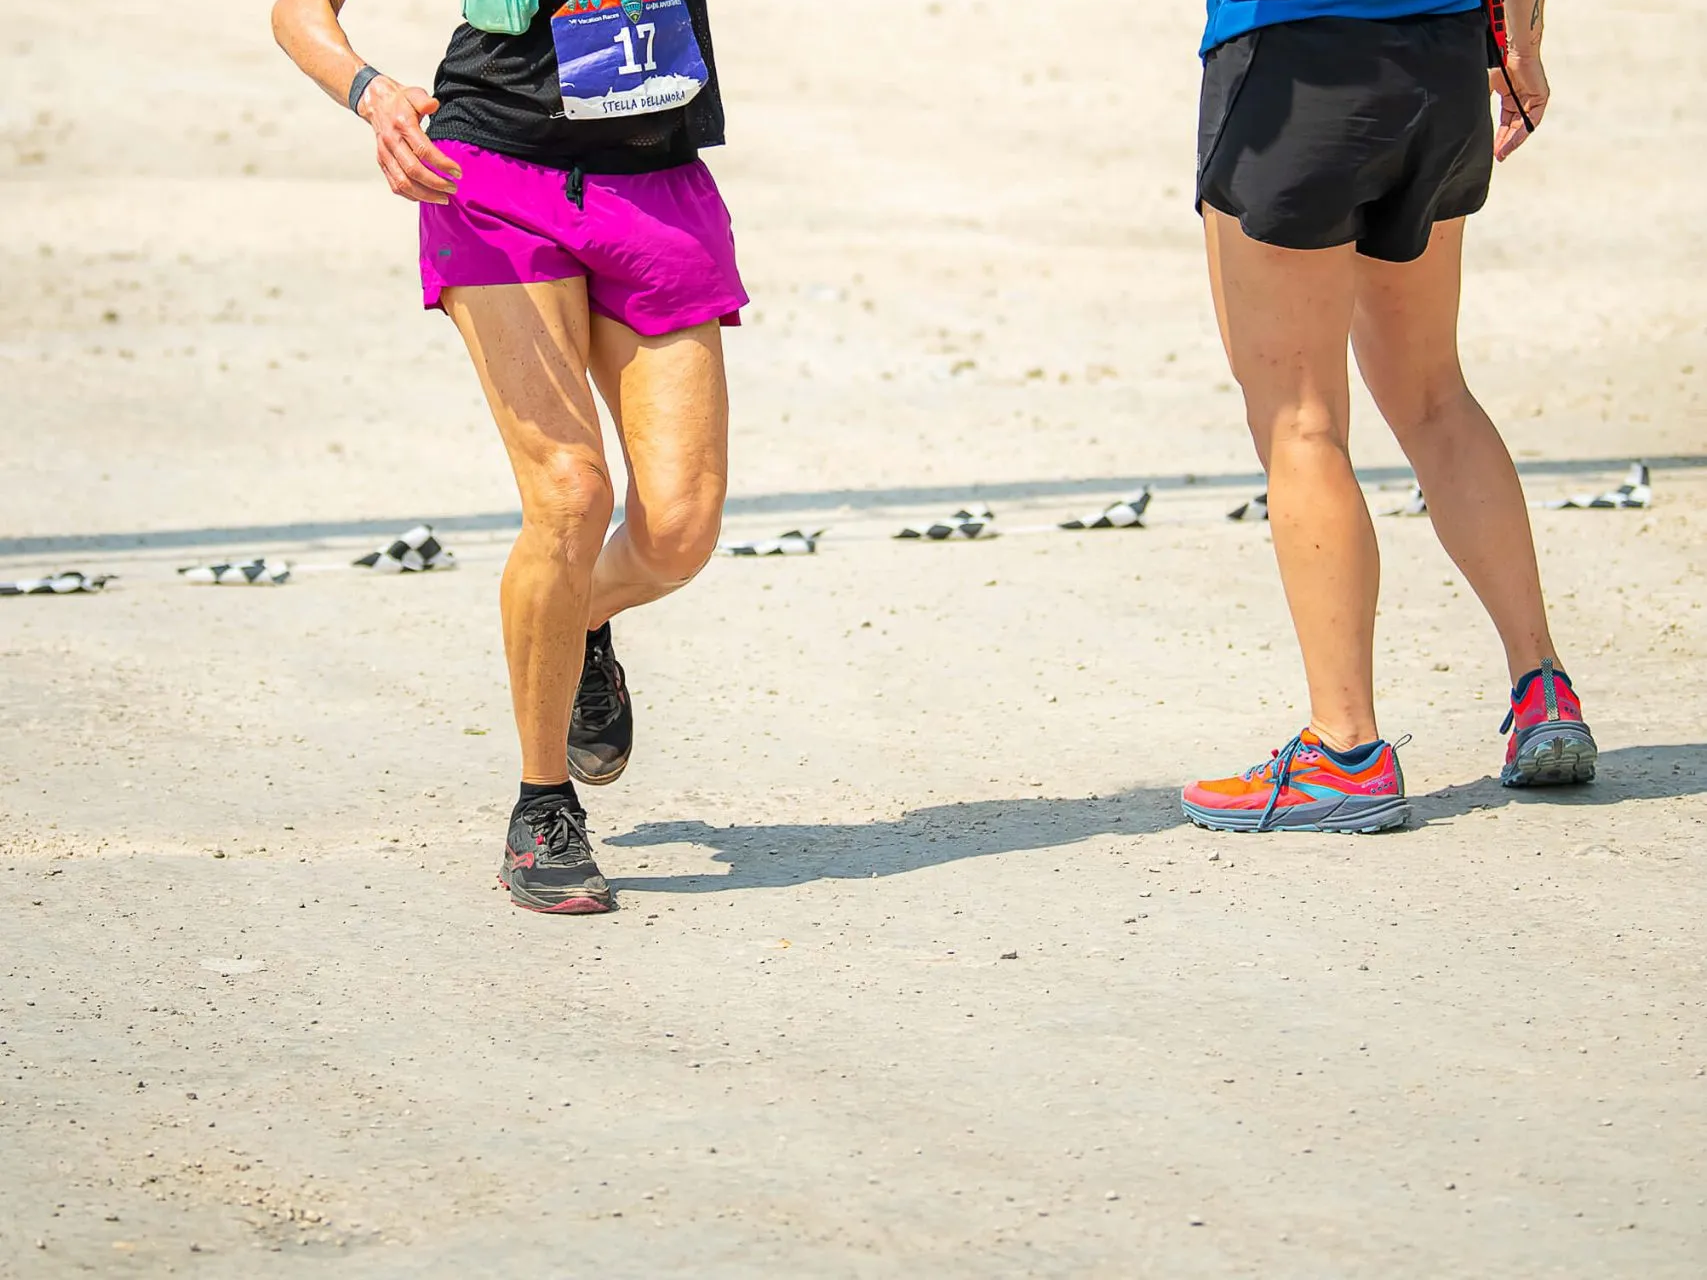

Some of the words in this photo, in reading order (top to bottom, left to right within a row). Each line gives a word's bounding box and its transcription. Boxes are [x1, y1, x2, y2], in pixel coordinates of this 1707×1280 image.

[613, 22, 657, 75] 17
[603, 99, 638, 113] STELLA
[641, 90, 686, 108] DELLAMORA
